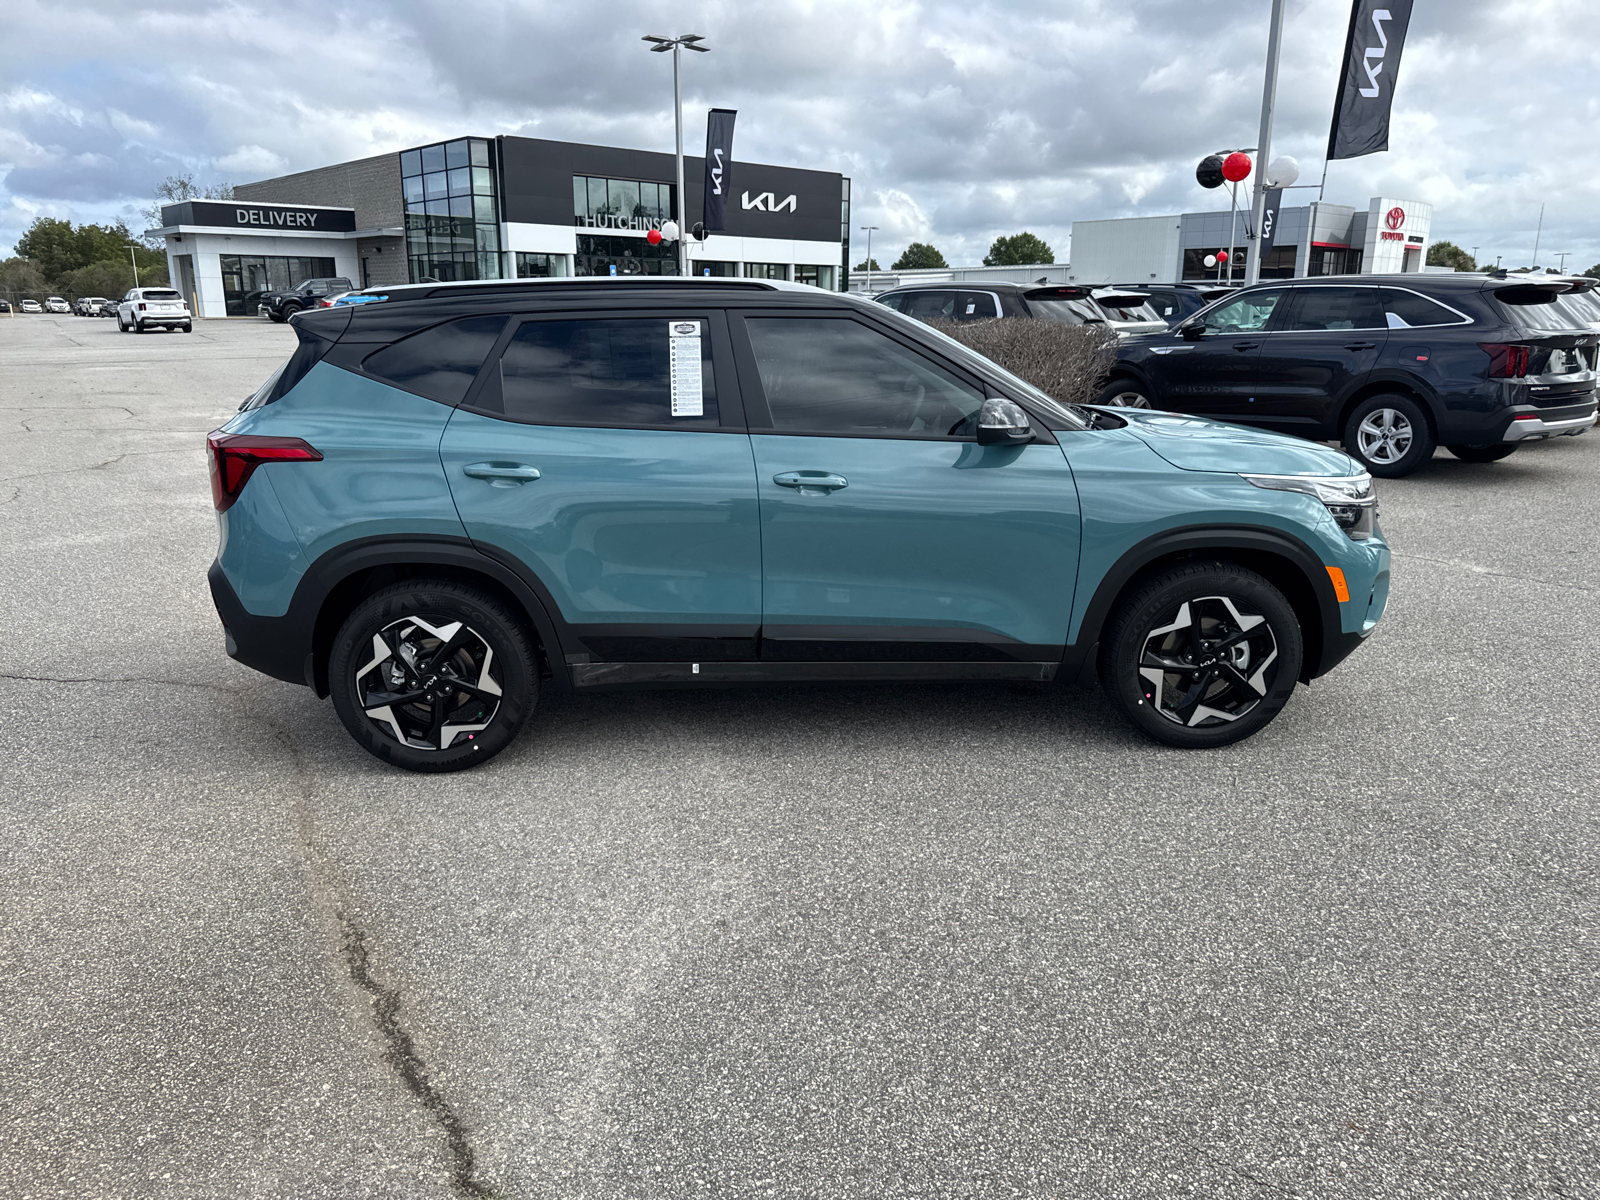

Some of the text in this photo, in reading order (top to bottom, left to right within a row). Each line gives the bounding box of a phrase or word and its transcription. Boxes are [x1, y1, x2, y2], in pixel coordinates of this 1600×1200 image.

[741, 190, 797, 214] KIA
[236, 209, 318, 227] DELIVERY
[1381, 231, 1404, 241] TOYOTA
[459, 605, 513, 652] SOLUS
[1129, 593, 1172, 645] SOLUS
